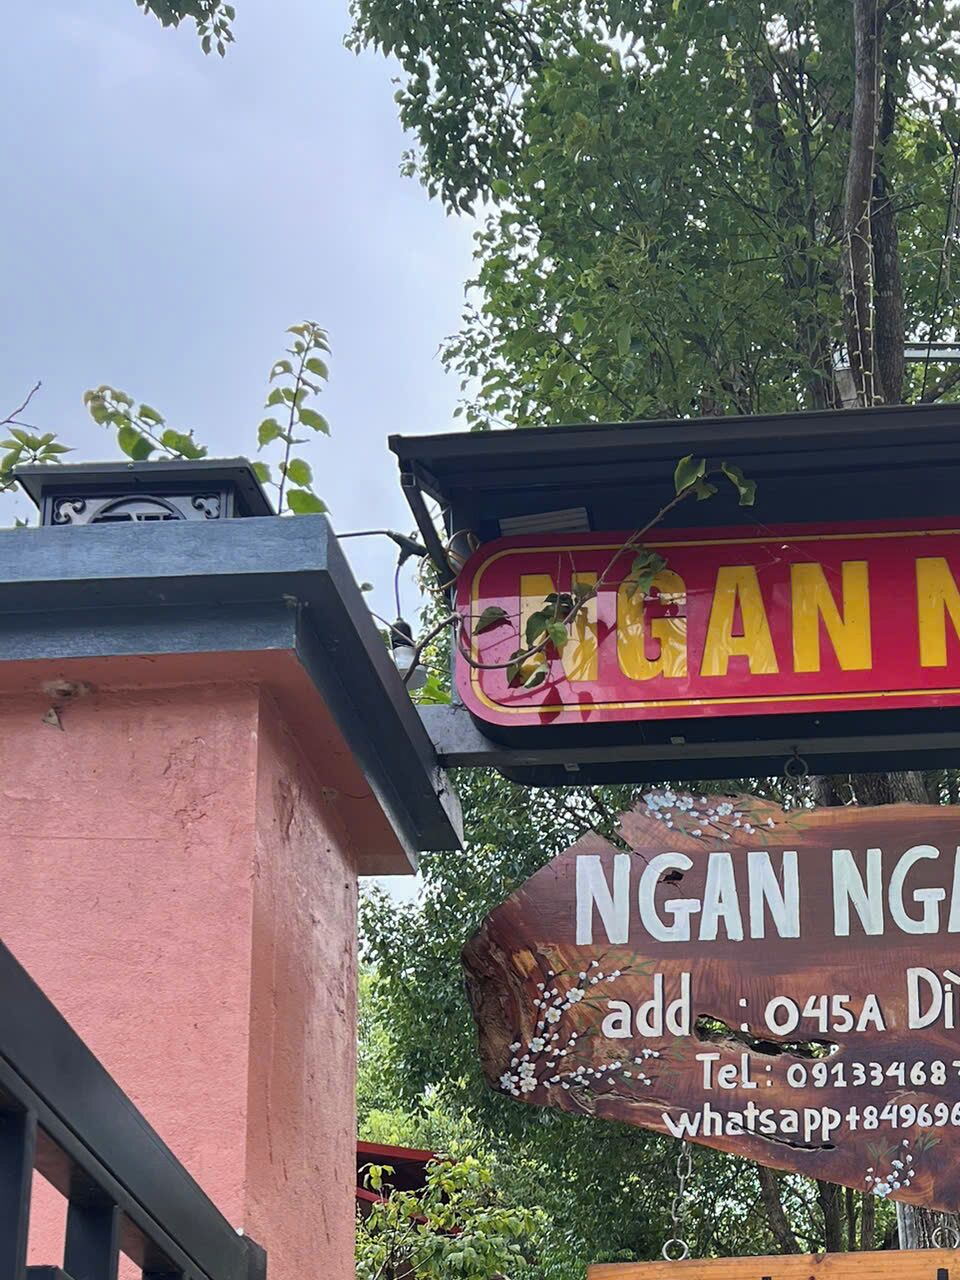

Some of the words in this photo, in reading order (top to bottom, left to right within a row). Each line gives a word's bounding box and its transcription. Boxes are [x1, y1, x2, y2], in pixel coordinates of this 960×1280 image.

[518, 561, 874, 682] NGAN
[574, 850, 801, 946] NGAN
[600, 972, 692, 1039] add
